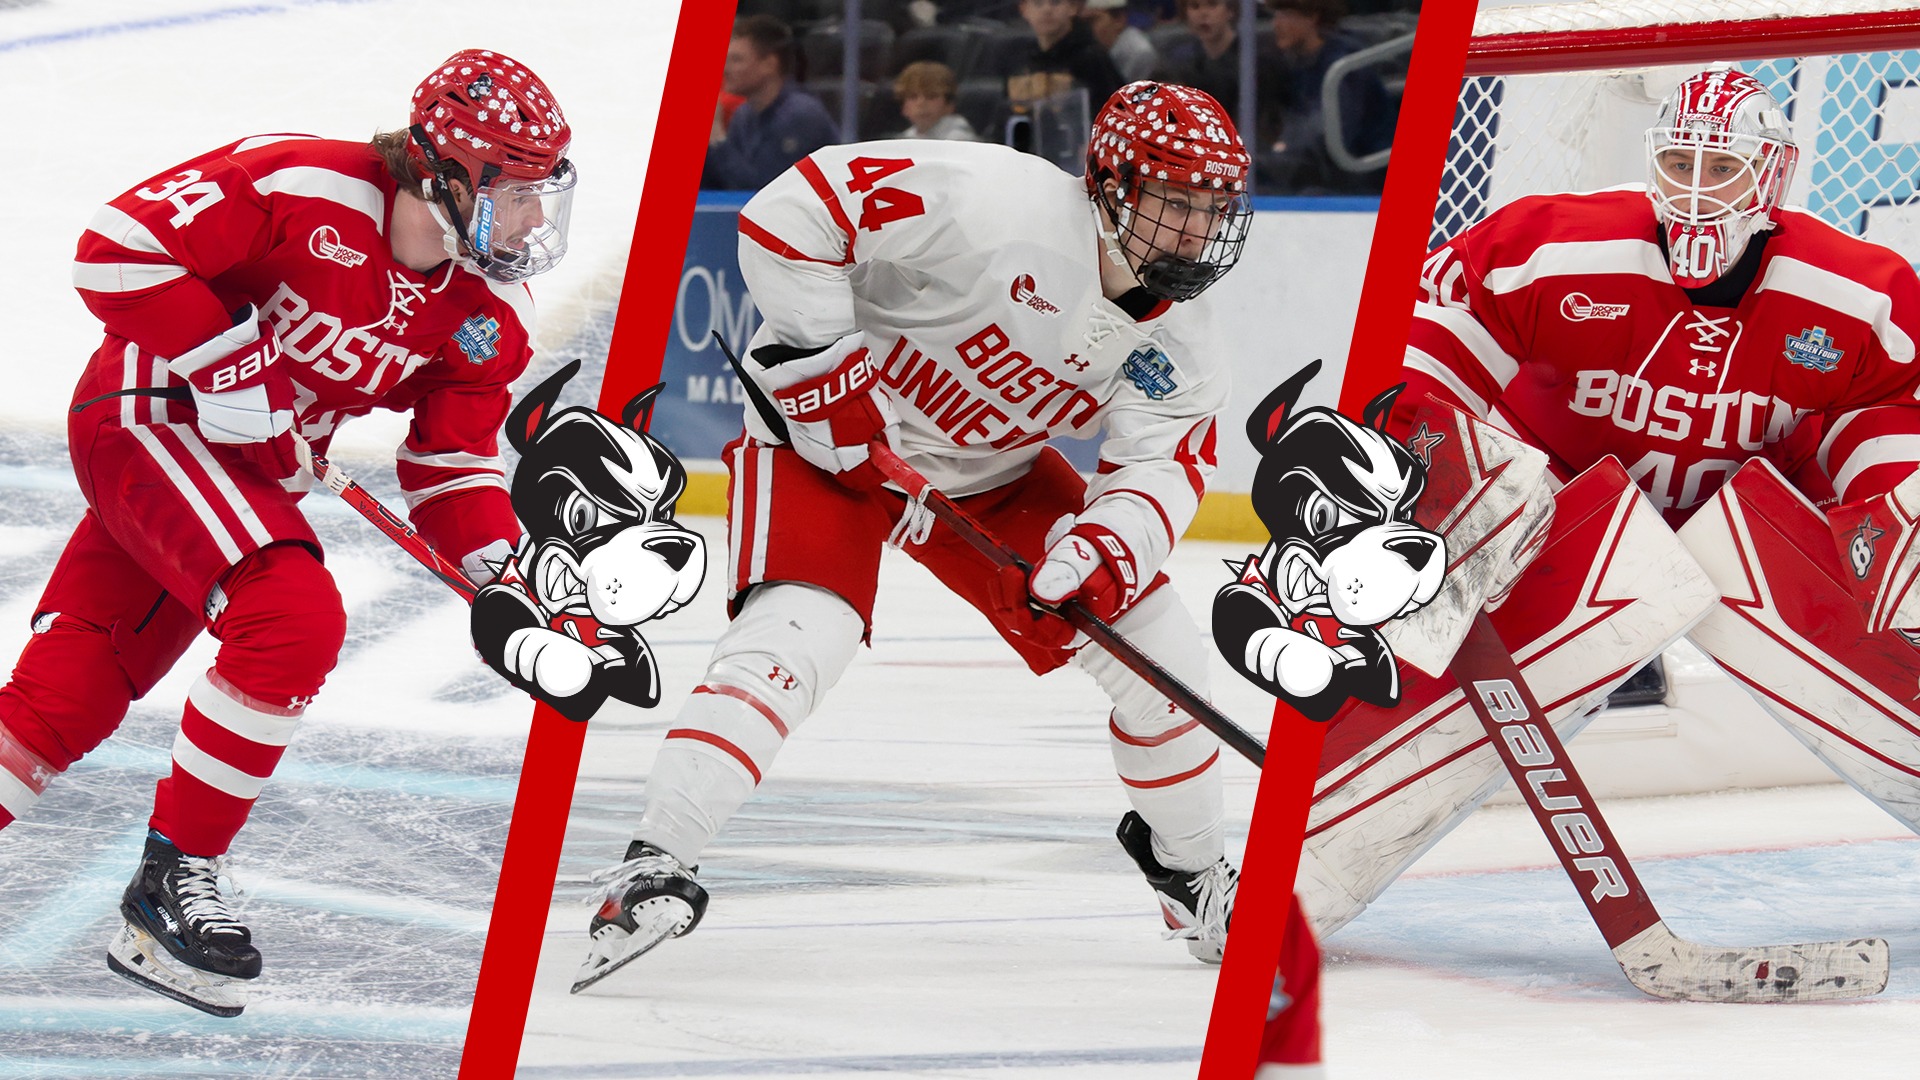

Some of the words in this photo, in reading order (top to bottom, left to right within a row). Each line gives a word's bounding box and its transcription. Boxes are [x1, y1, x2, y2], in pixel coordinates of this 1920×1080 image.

[1206, 124, 1231, 145] 44
[846, 156, 926, 232] 44
[1204, 160, 1241, 178] BOSTON
[135, 169, 225, 230] 34
[479, 199, 493, 253] BAUER
[336, 246, 364, 262] HOCKEY
[1419, 246, 1472, 311] 40
[1671, 233, 1716, 279] 40
[1030, 294, 1061, 314] HOCKEY
[1591, 305, 1626, 313] HOCKEY
[212, 335, 284, 393] BAU
[258, 281, 434, 396] BOST
[1790, 340, 1819, 355] FROZEN
[1818, 347, 1839, 361] FOUR
[779, 350, 879, 416] BAUER
[880, 335, 1050, 454] UNIVE
[955, 323, 1098, 430] BOSTO
[1131, 355, 1157, 378] FROZEN
[1152, 374, 1172, 391] FOUR
[1568, 369, 1816, 451] BOSTON
[1472, 678, 1630, 904] BAUER
